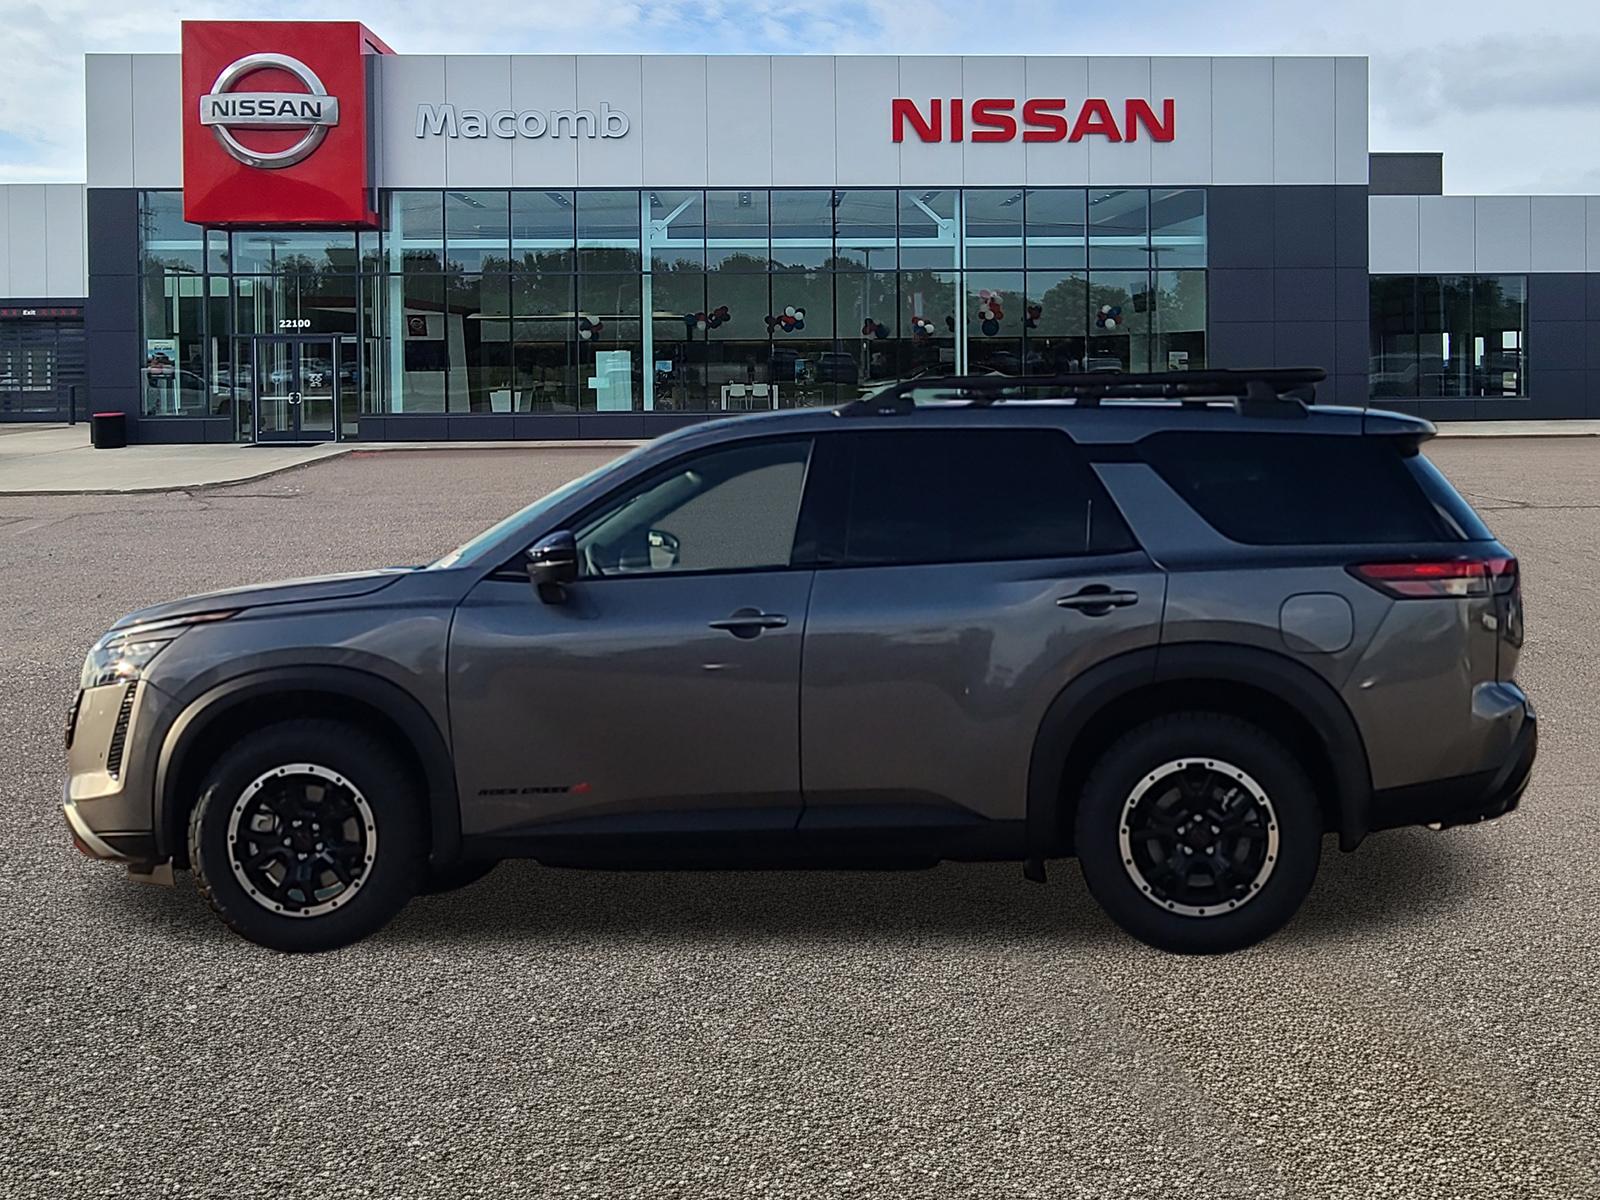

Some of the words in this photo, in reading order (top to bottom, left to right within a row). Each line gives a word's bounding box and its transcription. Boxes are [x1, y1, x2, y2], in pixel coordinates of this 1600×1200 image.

[212, 96, 322, 118] NISSAN
[415, 103, 630, 139] Macomb
[892, 98, 1176, 143] NISSAN
[279, 319, 311, 328] 22100
